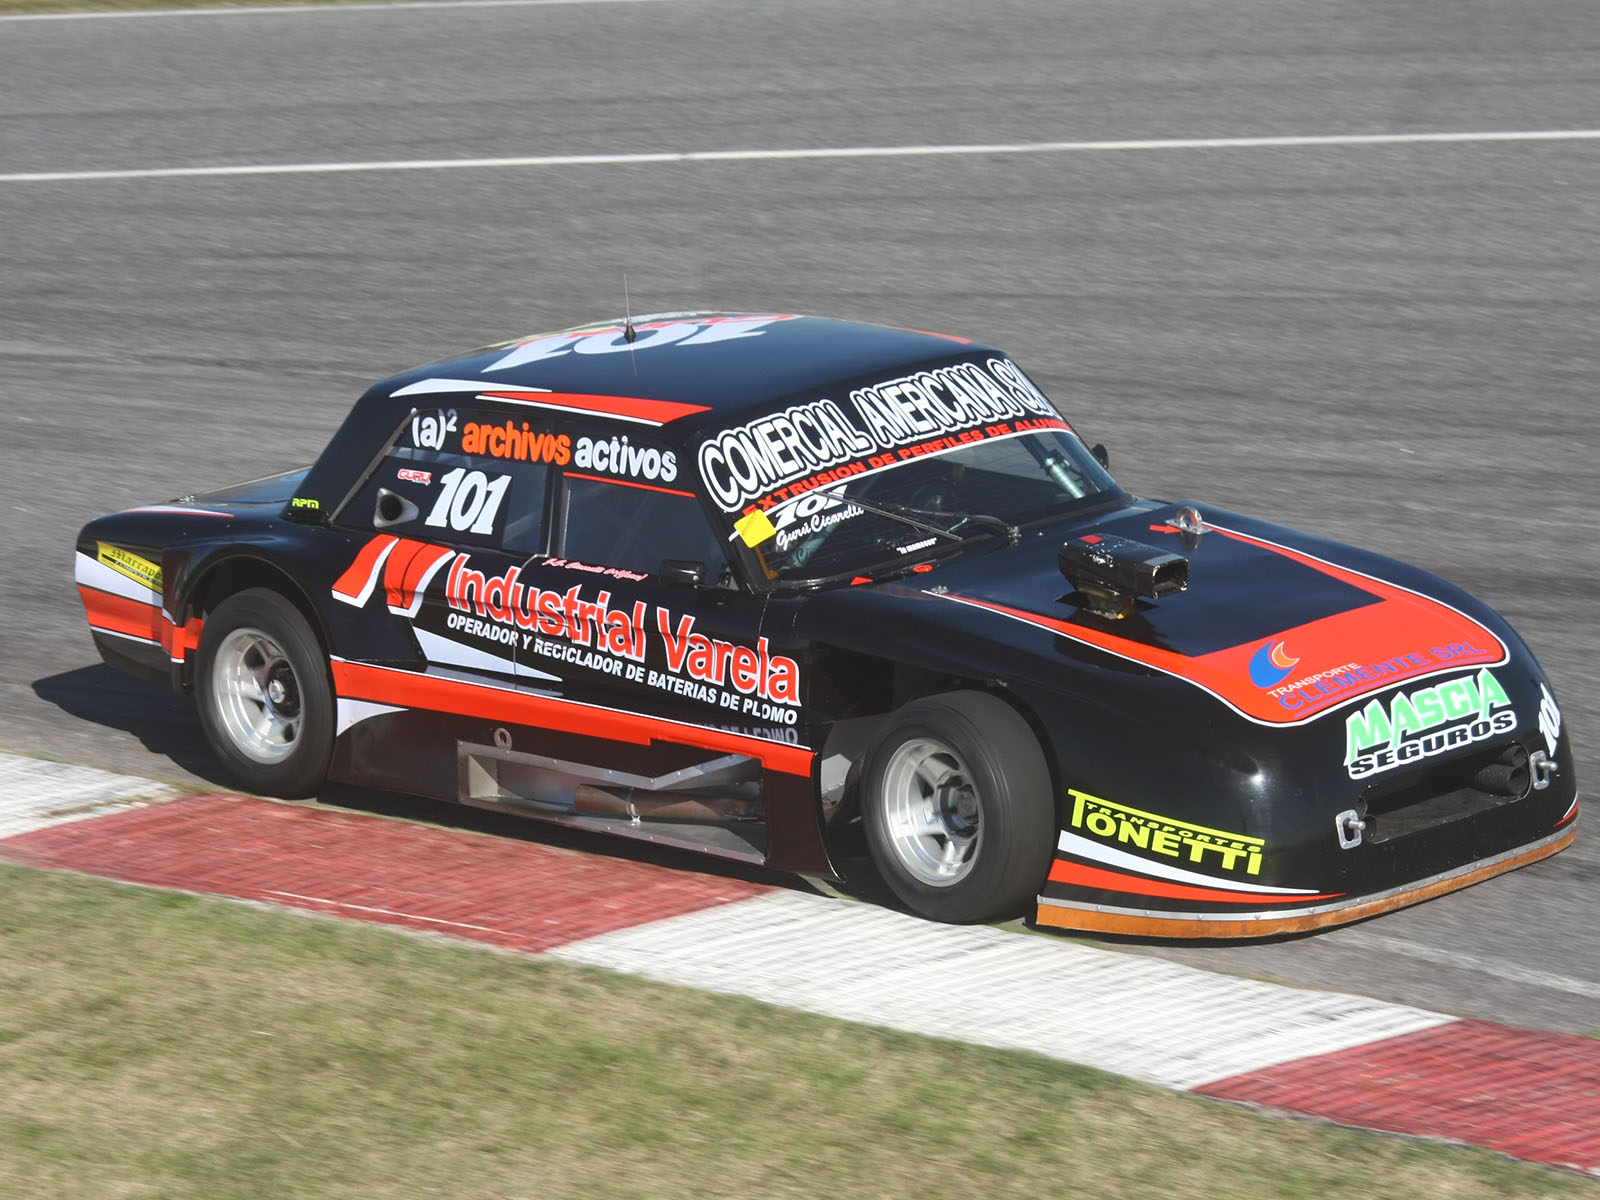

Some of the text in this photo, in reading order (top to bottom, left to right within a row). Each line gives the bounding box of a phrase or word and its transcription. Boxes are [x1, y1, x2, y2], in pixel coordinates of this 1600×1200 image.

[462, 420, 571, 466] archivos
[574, 436, 678, 482] activos
[698, 399, 872, 512] COMERCIAL
[850, 363, 1026, 448] AMERICANA
[742, 461, 868, 517] EXTRUSION
[869, 452, 898, 468] DE
[897, 429, 985, 461] PERFILES
[985, 422, 1013, 438] DE
[291, 497, 320, 510] RPM
[425, 468, 512, 535] 101
[445, 552, 802, 707] Industrial Varela
[447, 612, 798, 726] OPERADOR Y RECICLADOR DE BATERIAS DE PLOMO
[1267, 662, 1361, 699] TRANSPORTE
[1279, 641, 1488, 710] CLEMENTE SRL
[1343, 667, 1512, 766] MASCIA
[1348, 710, 1517, 780] SEGUROS
[1067, 788, 1266, 876] TONETTI
[1086, 802, 1263, 853] TRANSPORTES
